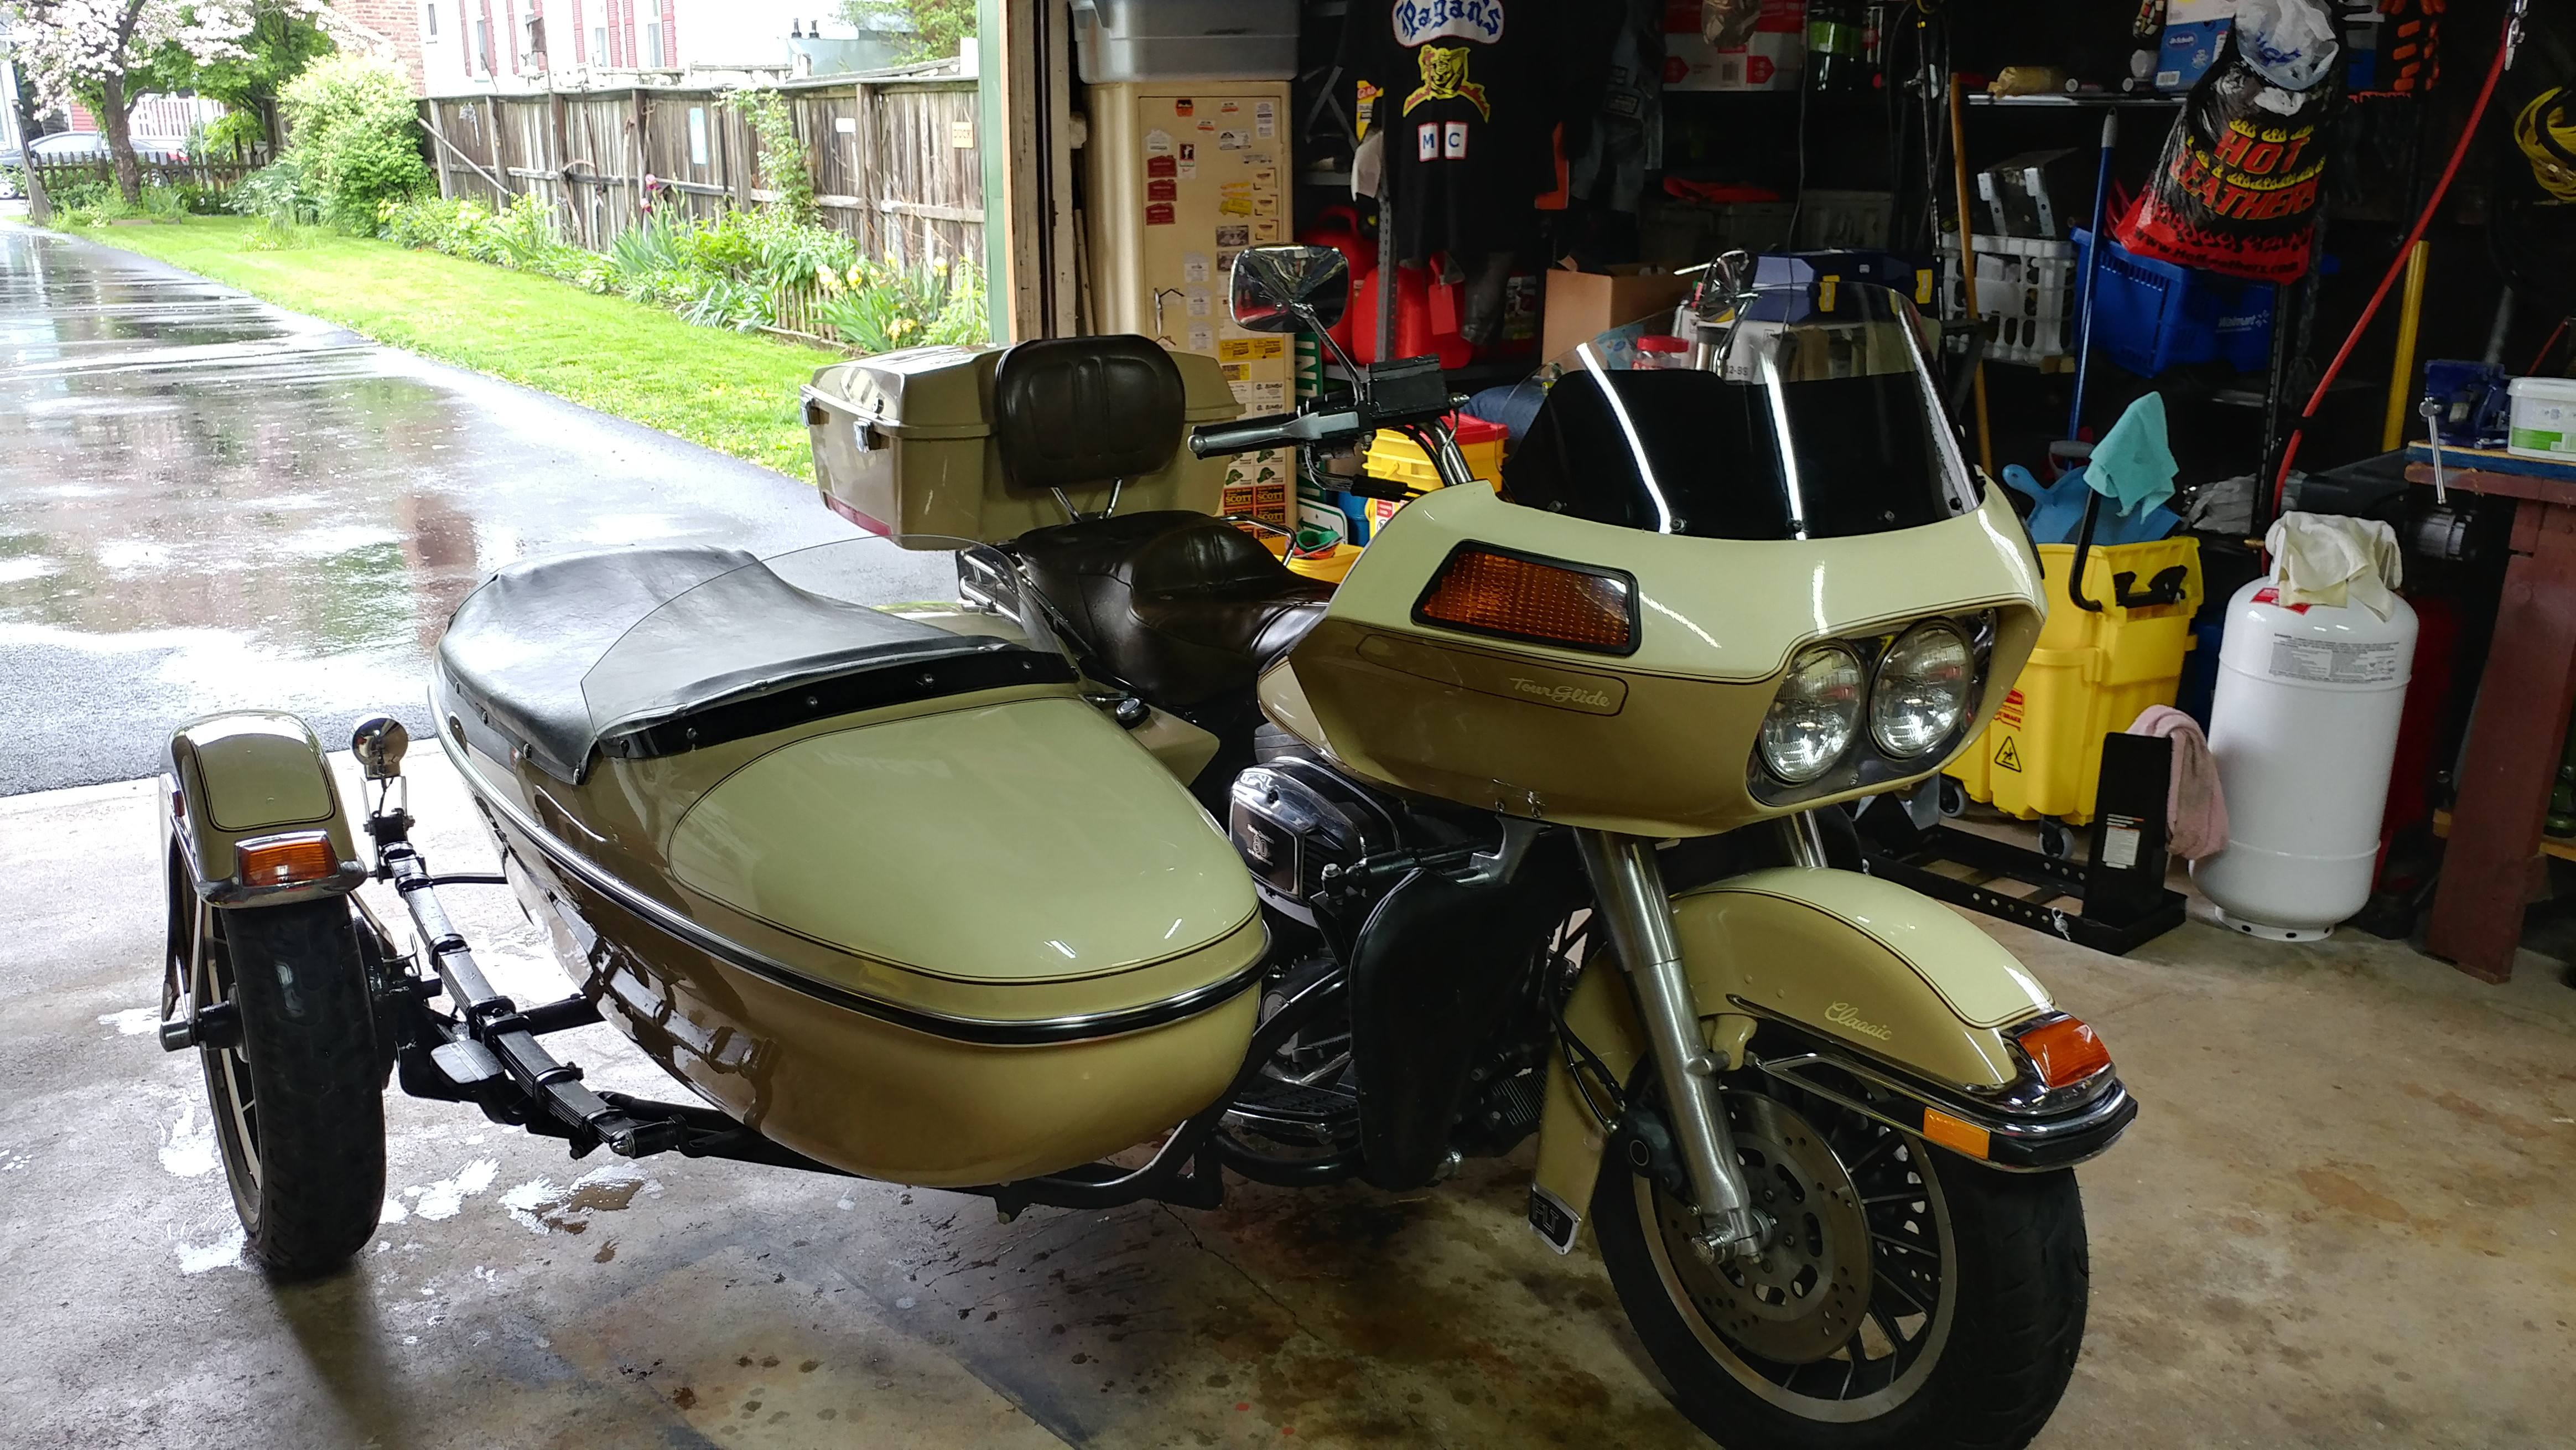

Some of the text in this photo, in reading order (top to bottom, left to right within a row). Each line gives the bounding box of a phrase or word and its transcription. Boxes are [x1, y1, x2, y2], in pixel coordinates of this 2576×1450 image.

[1396, 0, 1501, 42] Pagan's
[1423, 132, 1460, 149] M C
[2214, 128, 2311, 175] HOT
[2169, 145, 2320, 220] LEATHERS
[1225, 495, 1252, 503] SCOTT
[1257, 491, 1284, 500] SCOTT
[1825, 1001, 1892, 1040] Classic
